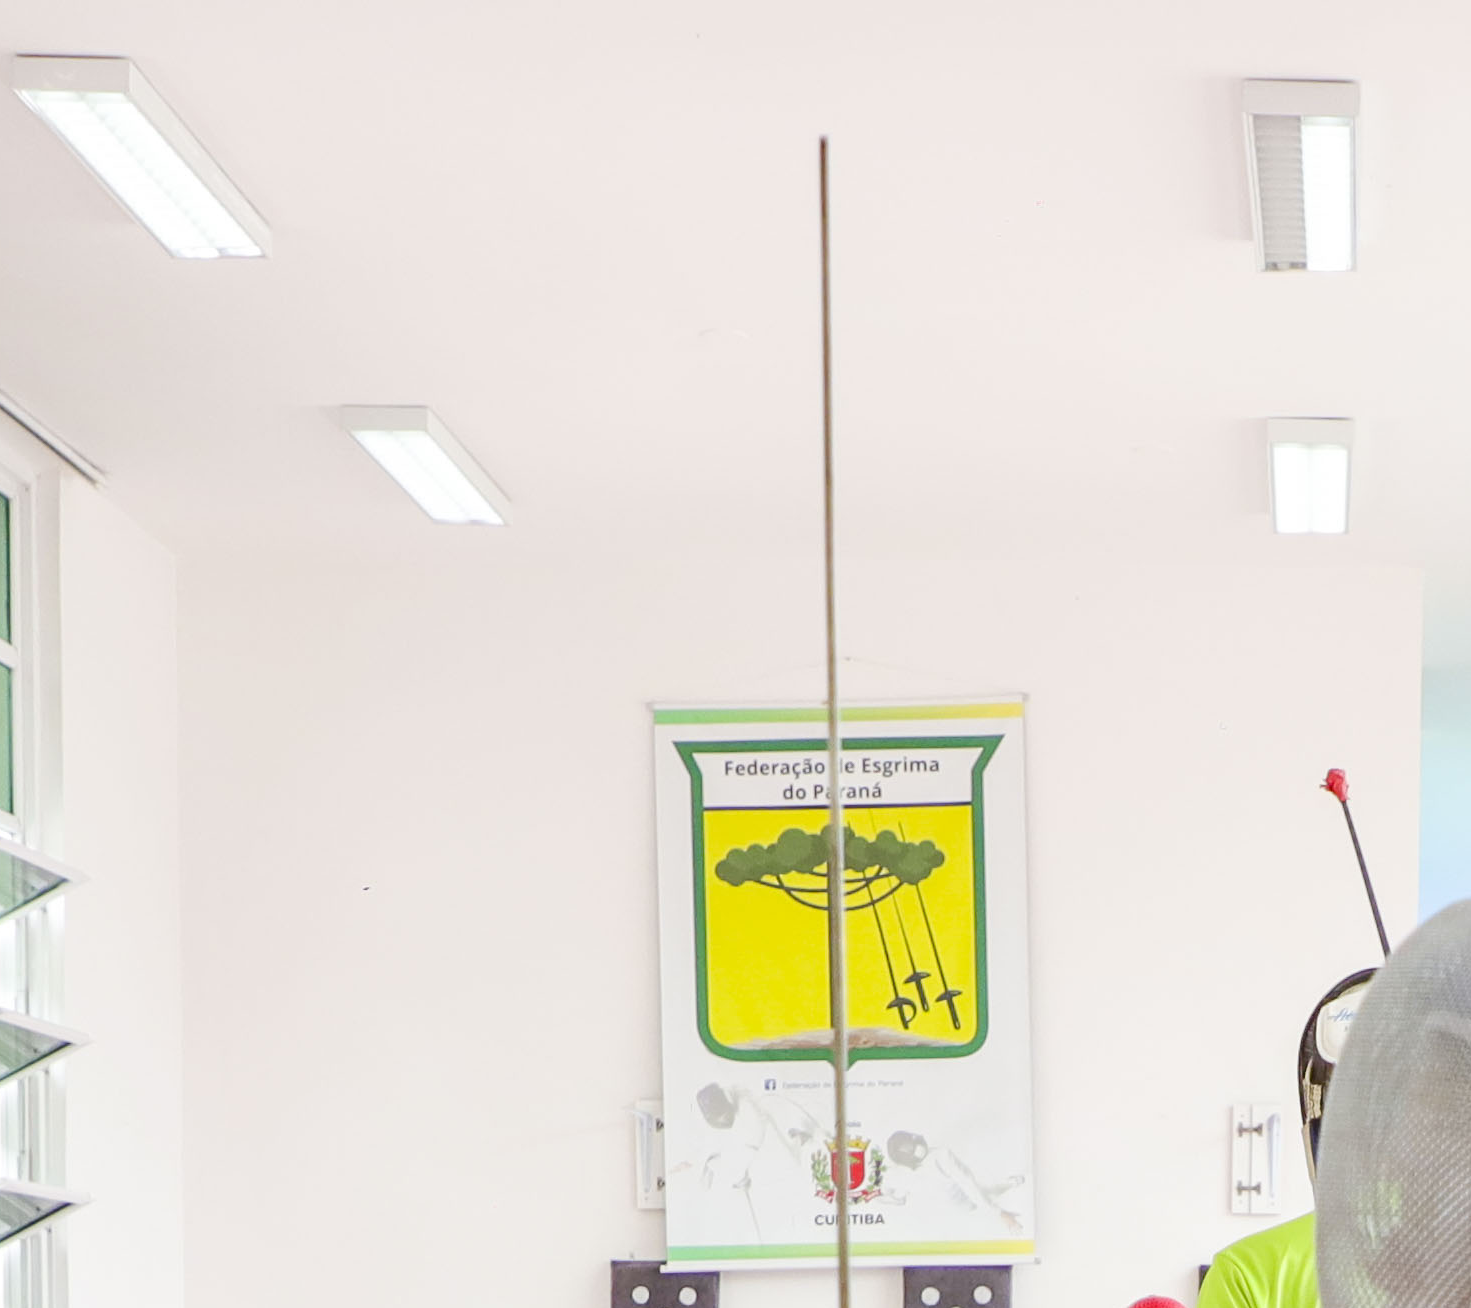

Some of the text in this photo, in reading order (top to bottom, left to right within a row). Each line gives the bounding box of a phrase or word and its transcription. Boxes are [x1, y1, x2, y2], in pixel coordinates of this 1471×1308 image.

[724, 758, 826, 778] Federação
[862, 756, 940, 777] Esgrima
[783, 784, 806, 800] do
